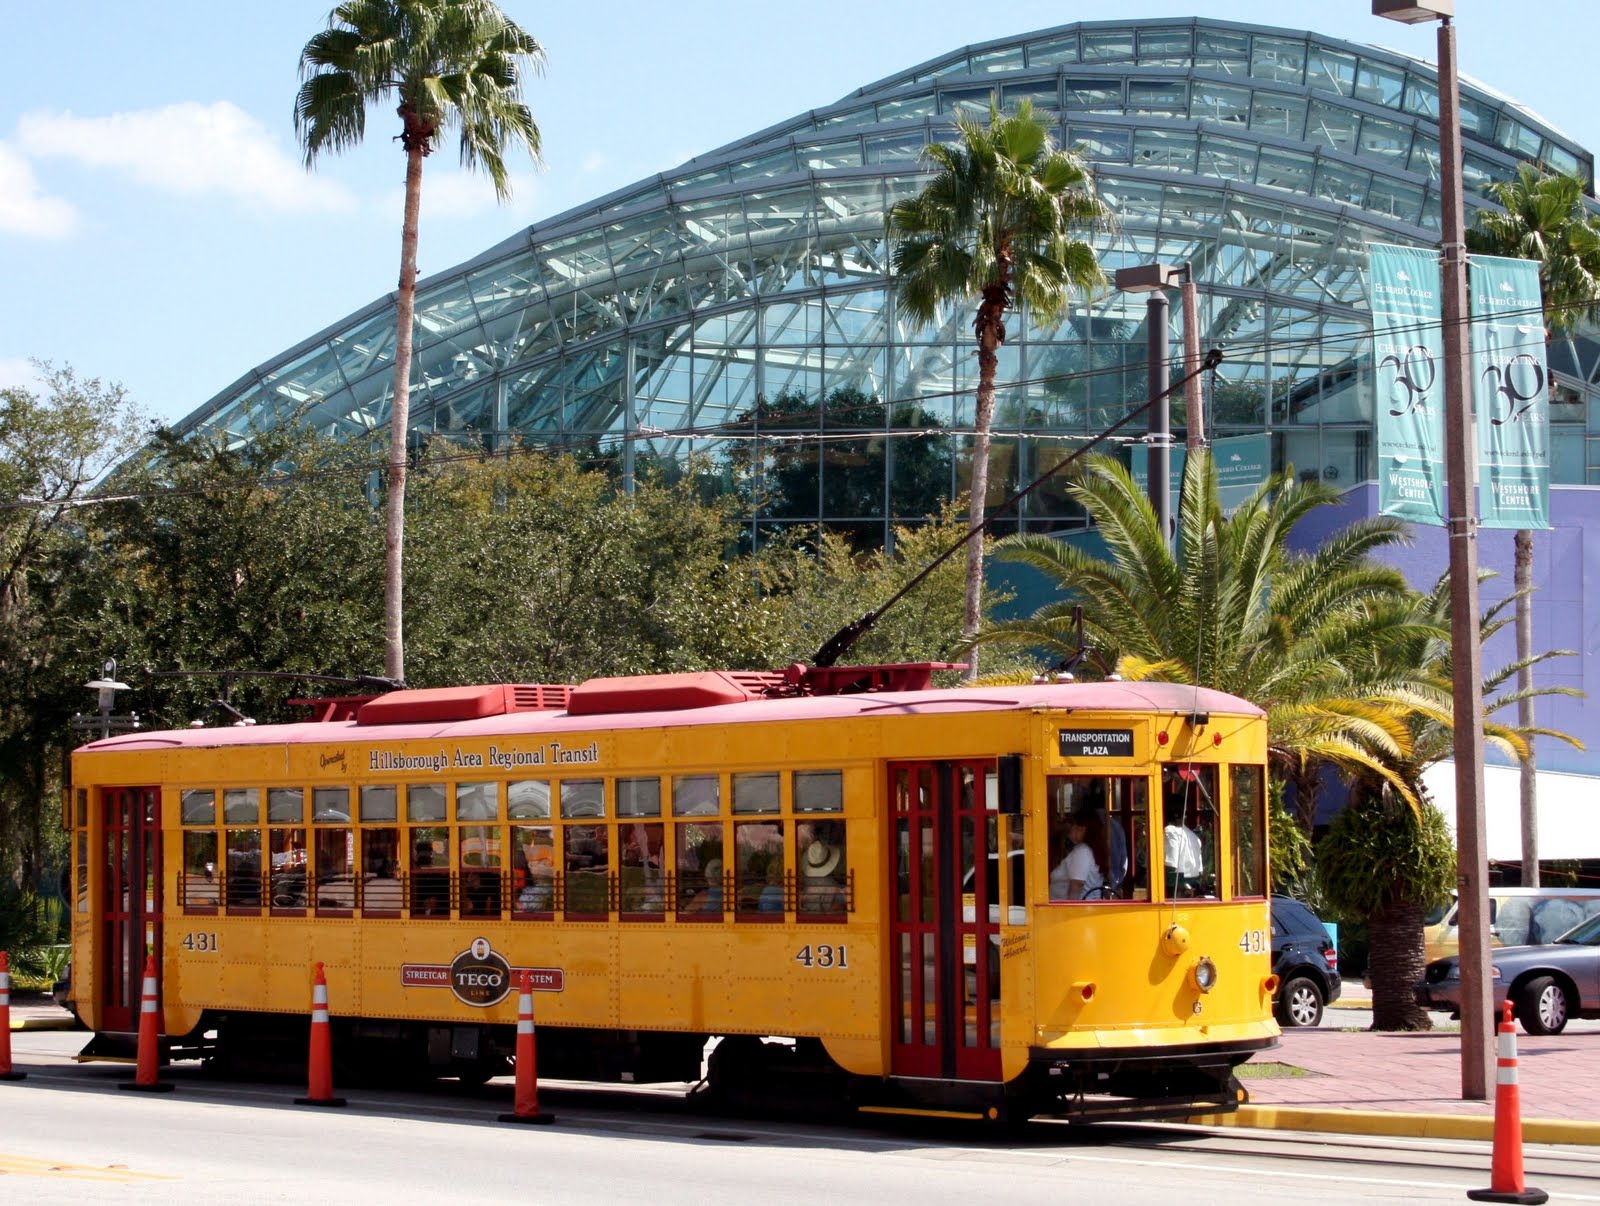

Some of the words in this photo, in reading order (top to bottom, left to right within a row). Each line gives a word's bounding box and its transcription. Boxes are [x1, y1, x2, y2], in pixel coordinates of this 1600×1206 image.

[1379, 345, 1435, 417] 30
[1481, 353, 1544, 426] 30
[1389, 473, 1434, 490] WESTSHORE
[1491, 481, 1540, 495] WESTSHORE
[1398, 485, 1425, 500] CENTER
[1500, 493, 1531, 506] CENTER
[1060, 733, 1130, 743] TRANSPORTATION
[369, 748, 448, 773] Hillsborough
[452, 747, 483, 768] Area
[488, 745, 545, 769] Regional
[550, 742, 598, 764] Transit
[1082, 746, 1109, 755] PLAZA
[182, 931, 220, 953] 431
[1238, 929, 1267, 953] 431
[795, 943, 849, 970] 431
[405, 970, 448, 981] STREETCAR
[455, 972, 502, 987] TECO
[519, 973, 553, 984] SSTEM
[470, 989, 490, 997] LINE
